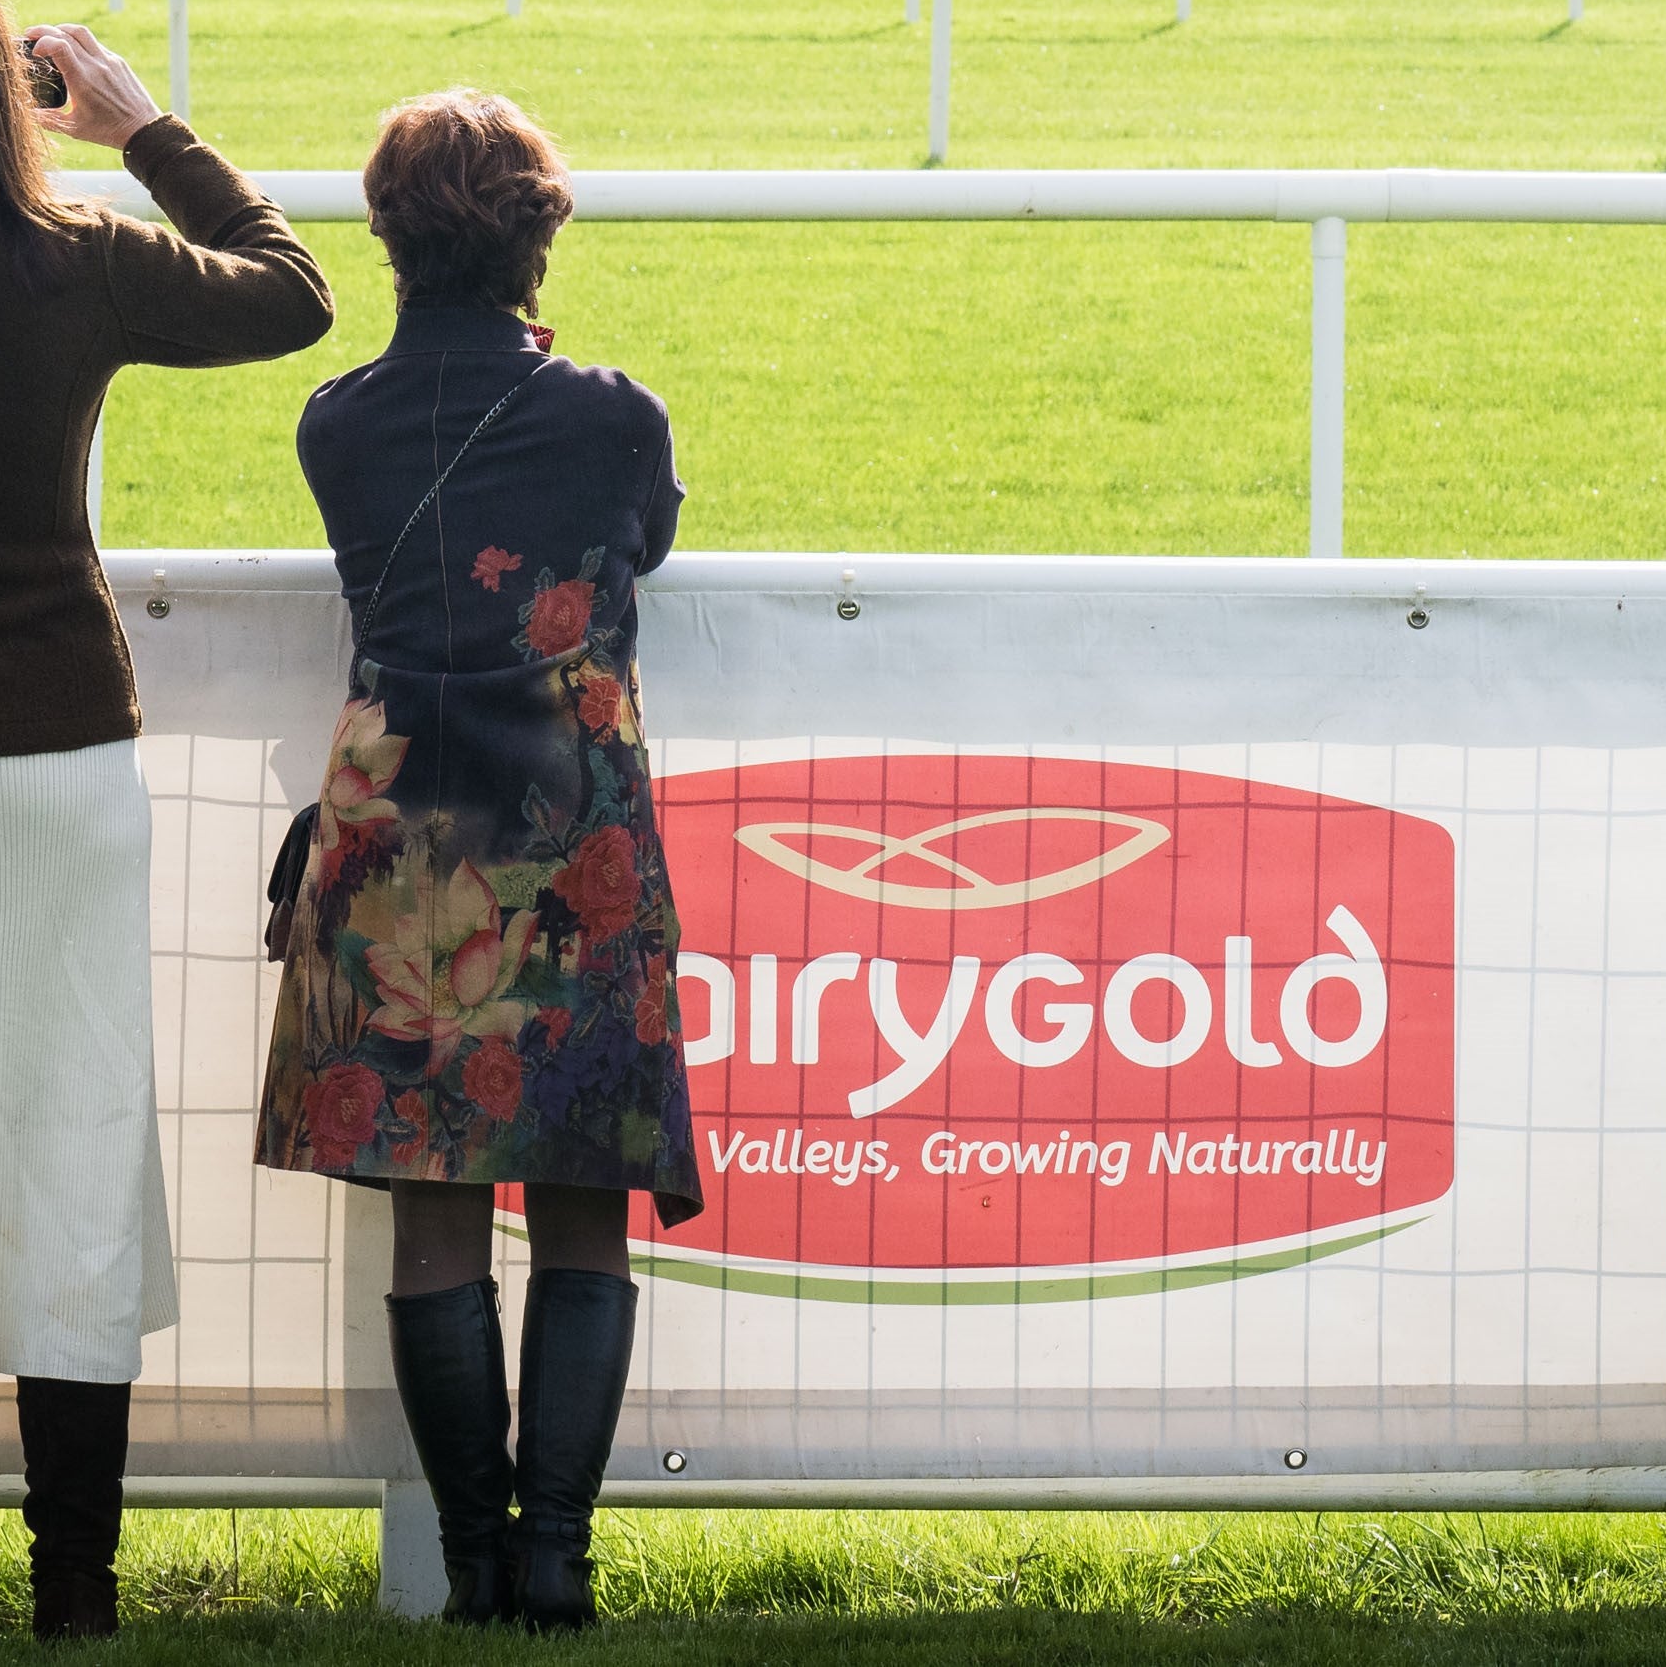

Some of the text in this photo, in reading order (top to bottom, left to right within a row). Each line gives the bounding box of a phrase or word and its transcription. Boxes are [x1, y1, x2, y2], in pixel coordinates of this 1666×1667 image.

[707, 1129, 1387, 1186] Valleys, Growing Naturally
